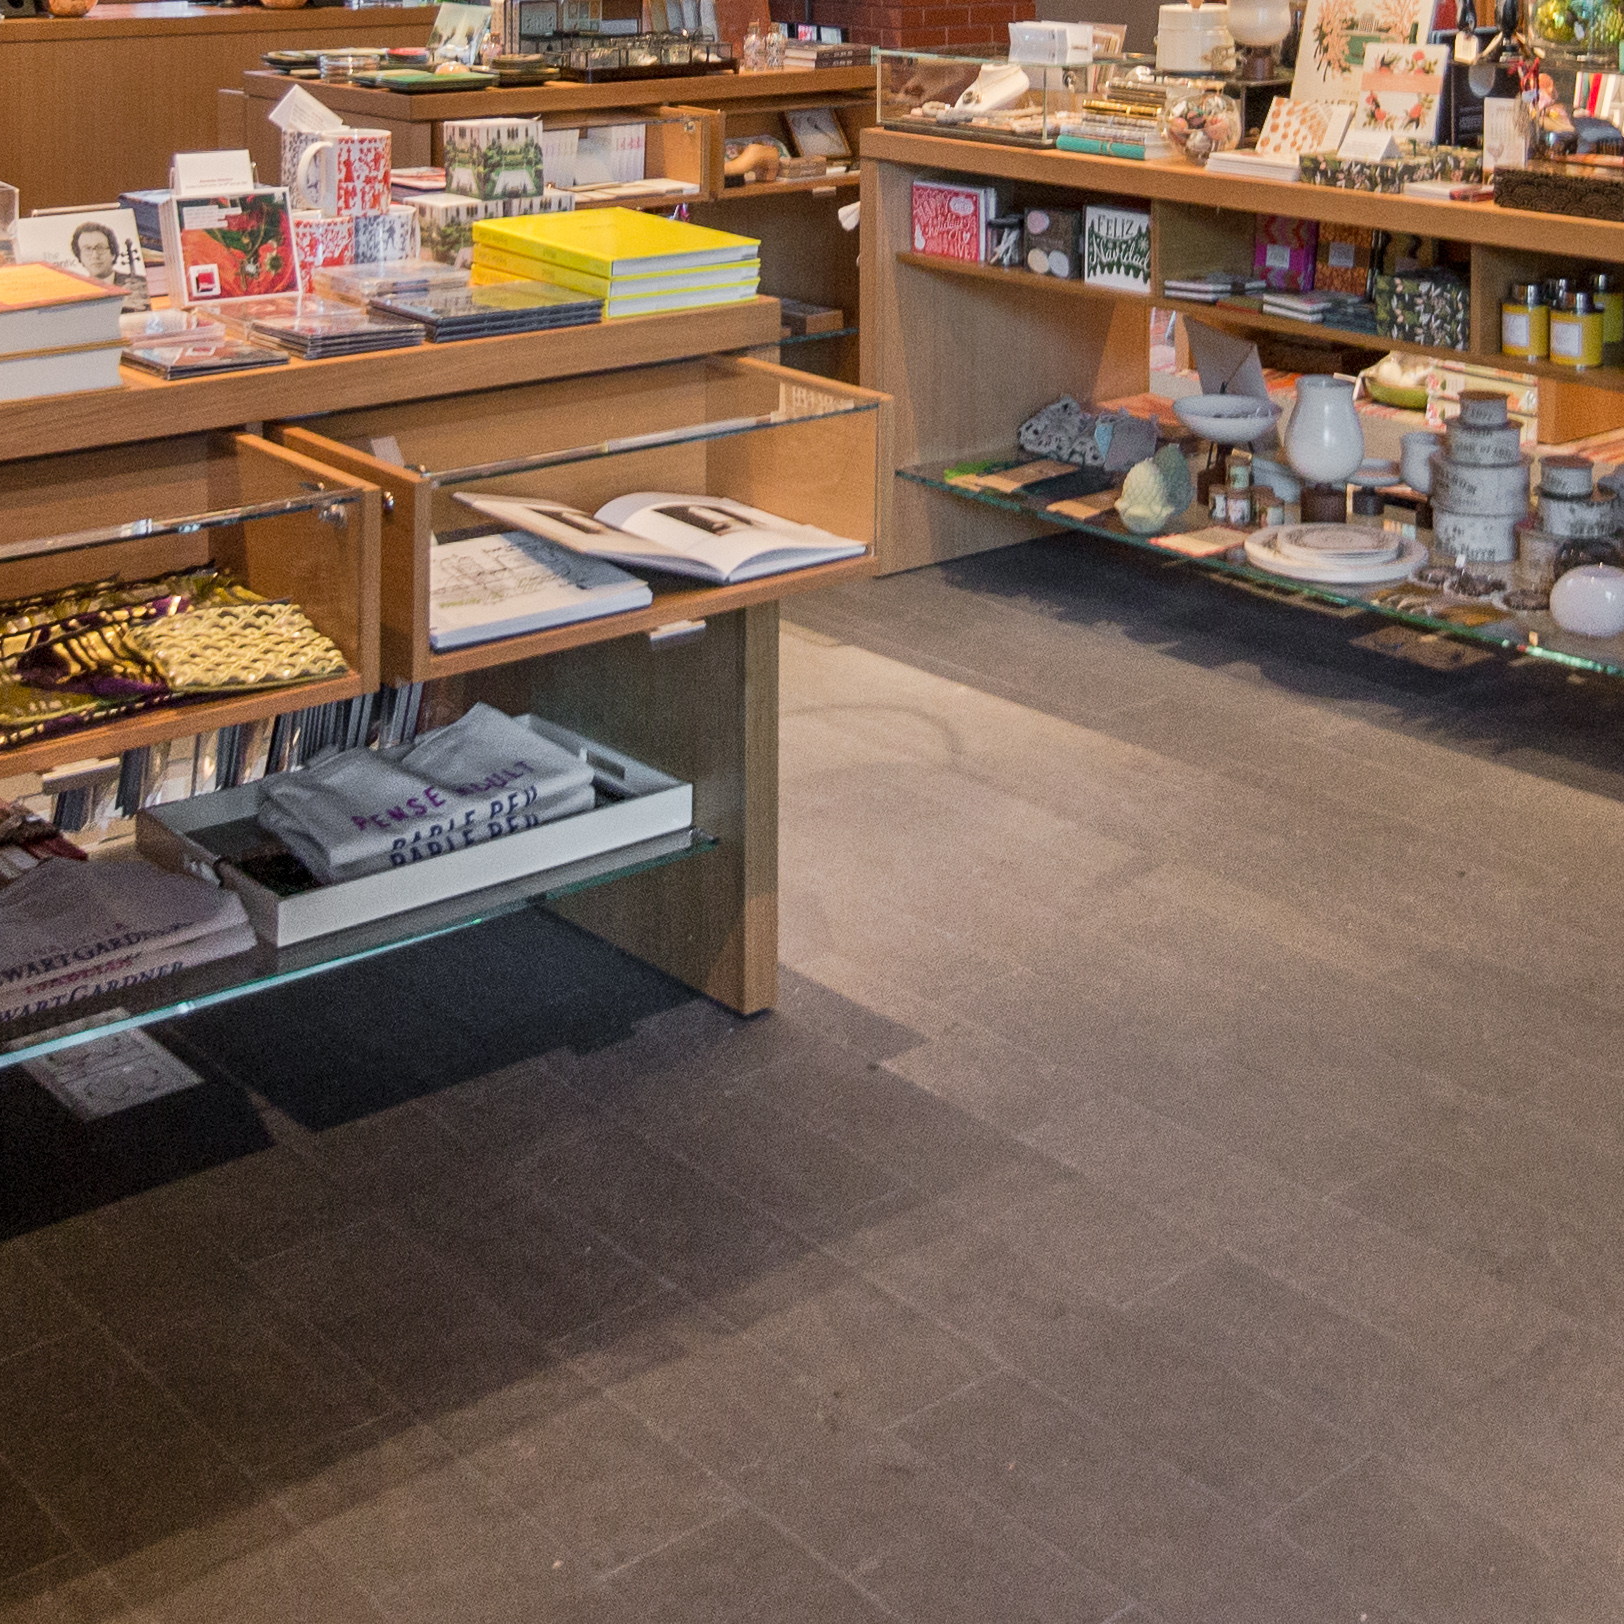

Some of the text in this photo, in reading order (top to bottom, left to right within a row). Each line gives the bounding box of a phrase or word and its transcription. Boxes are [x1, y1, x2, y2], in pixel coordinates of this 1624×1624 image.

[1097, 214, 1136, 238] FELIZ
[1089, 236, 1151, 272] Navidad
[351, 786, 446, 831] PENSE
